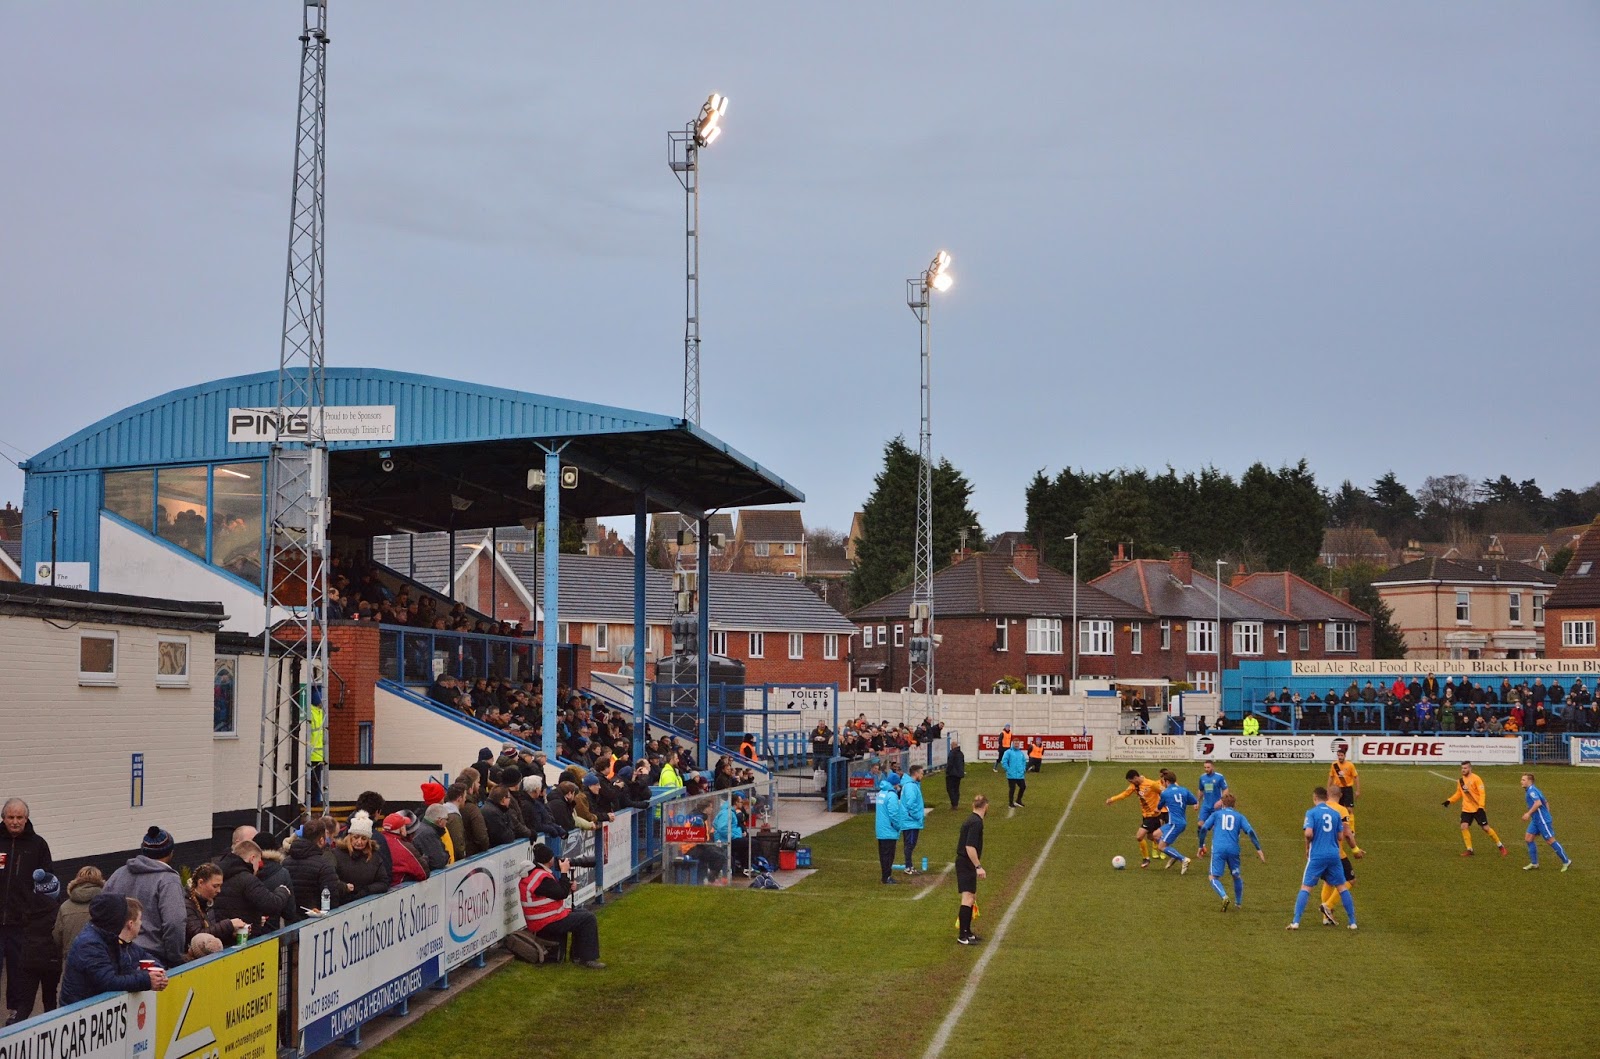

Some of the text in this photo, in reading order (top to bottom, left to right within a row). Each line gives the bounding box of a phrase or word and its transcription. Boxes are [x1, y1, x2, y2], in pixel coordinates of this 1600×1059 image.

[232, 414, 308, 435] PING
[325, 411, 341, 420] Proud
[349, 411, 356, 420] be
[358, 410, 381, 422] Sponsors
[323, 425, 360, 436] Gainsborough
[362, 424, 380, 436] Trinity
[1295, 662, 1320, 673] Real
[1324, 662, 1344, 673] Ale
[1350, 661, 1375, 672] Real
[1380, 661, 1407, 672] Food
[1414, 661, 1438, 672] Real
[1443, 661, 1465, 672] Pub
[1472, 661, 1508, 672] Black
[1513, 661, 1552, 671] Horse
[1558, 661, 1579, 671] Inn
[1124, 736, 1176, 745] Crosskills
[1266, 738, 1314, 747] Transport
[1362, 742, 1445, 756] EAGRE
[1174, 794, 1183, 808] 4
[1222, 814, 1235, 831] 10
[1322, 814, 1333, 832] 3
[458, 889, 489, 927] Brexons
[311, 894, 438, 995] J.H. Smithson & Son LTD
[236, 962, 265, 990] HYGIENE
[226, 992, 272, 1030] MANAGEMENT
[305, 998, 320, 1020] 01427
[332, 968, 422, 1038] PLUMBING & HEATING ENGINEERS
[61, 1018, 86, 1059] CAR
[90, 1002, 127, 1052] PARTS
